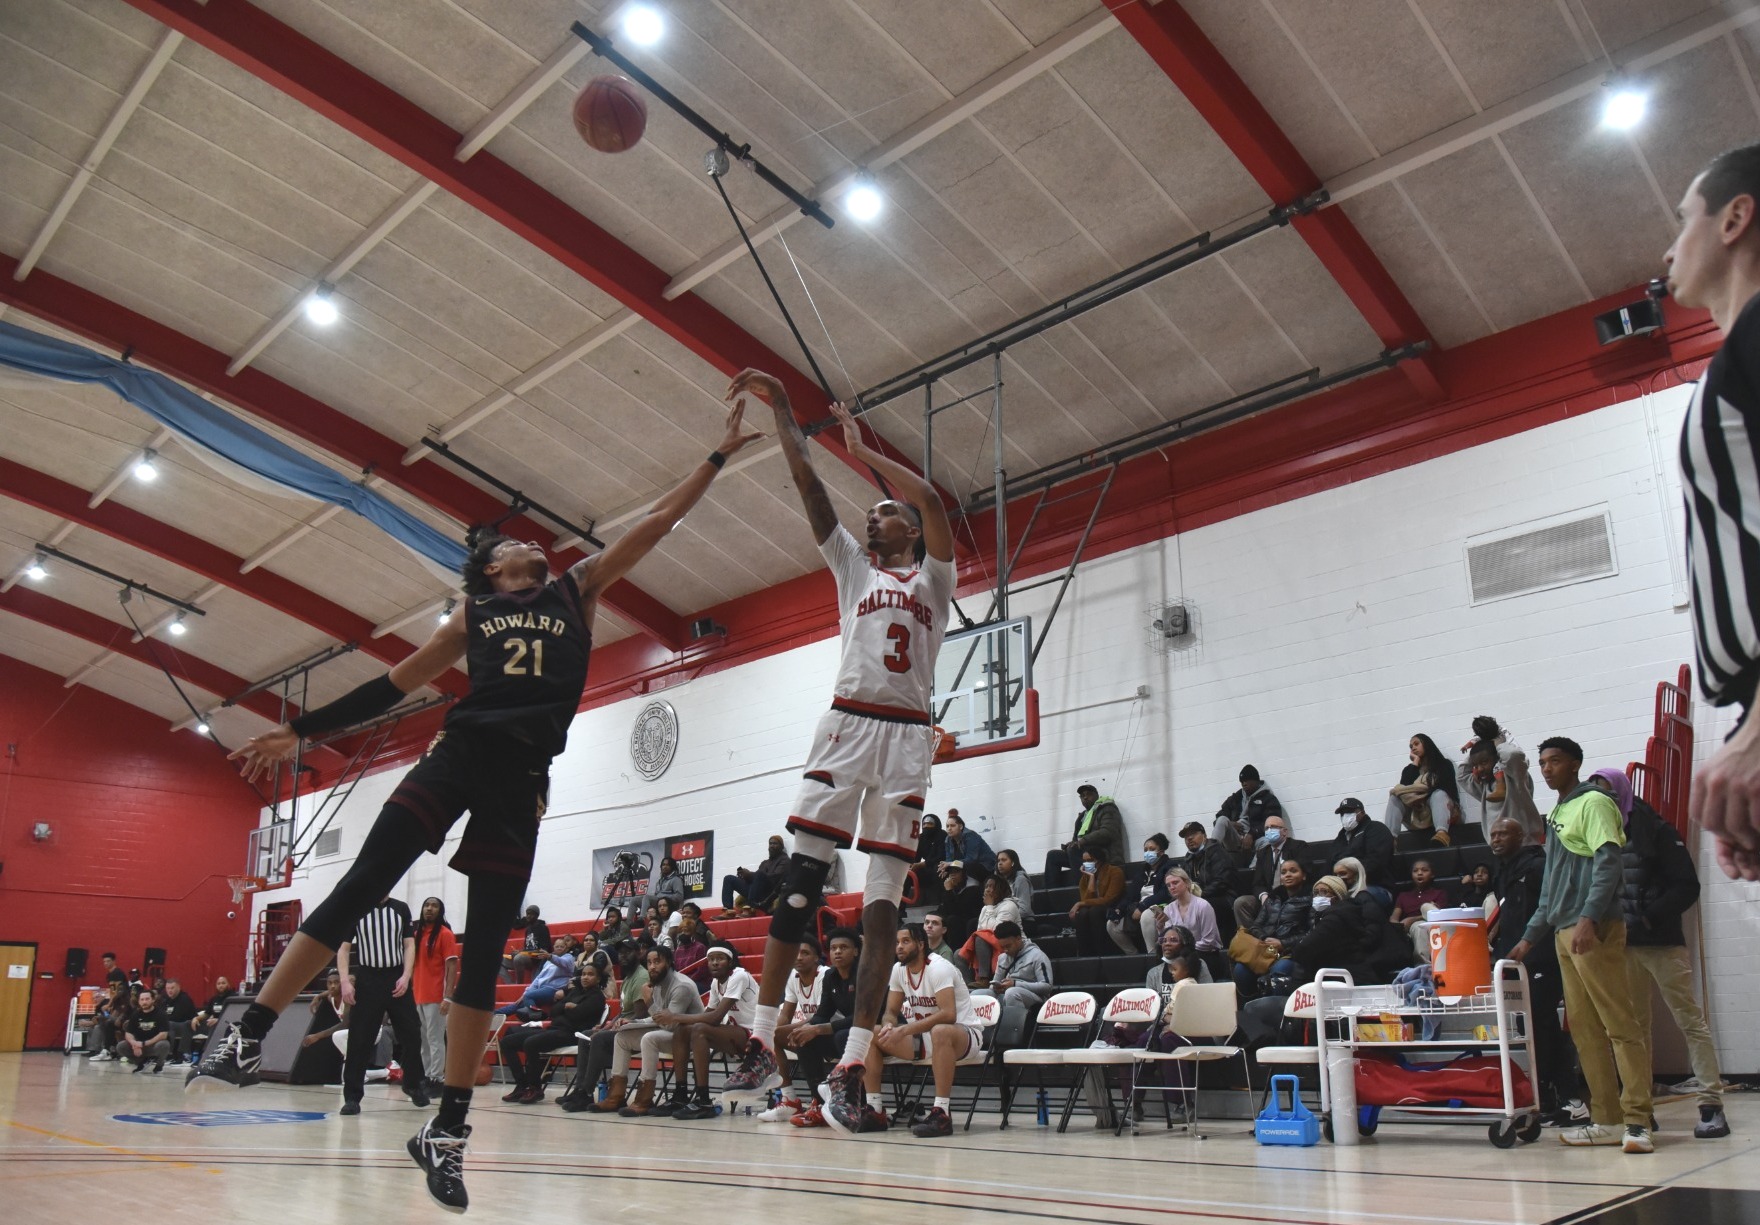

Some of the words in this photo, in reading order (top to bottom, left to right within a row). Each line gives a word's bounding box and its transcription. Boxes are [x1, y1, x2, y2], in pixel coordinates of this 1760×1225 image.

[480, 612, 565, 638] HOWARD
[503, 638, 542, 676] 21
[884, 622, 911, 674] 3
[676, 857, 706, 874] ROTECT
[1430, 927, 1443, 950] G
[1044, 999, 1091, 1020] BALTIMORE
[1110, 995, 1156, 1017] BALTIMORE
